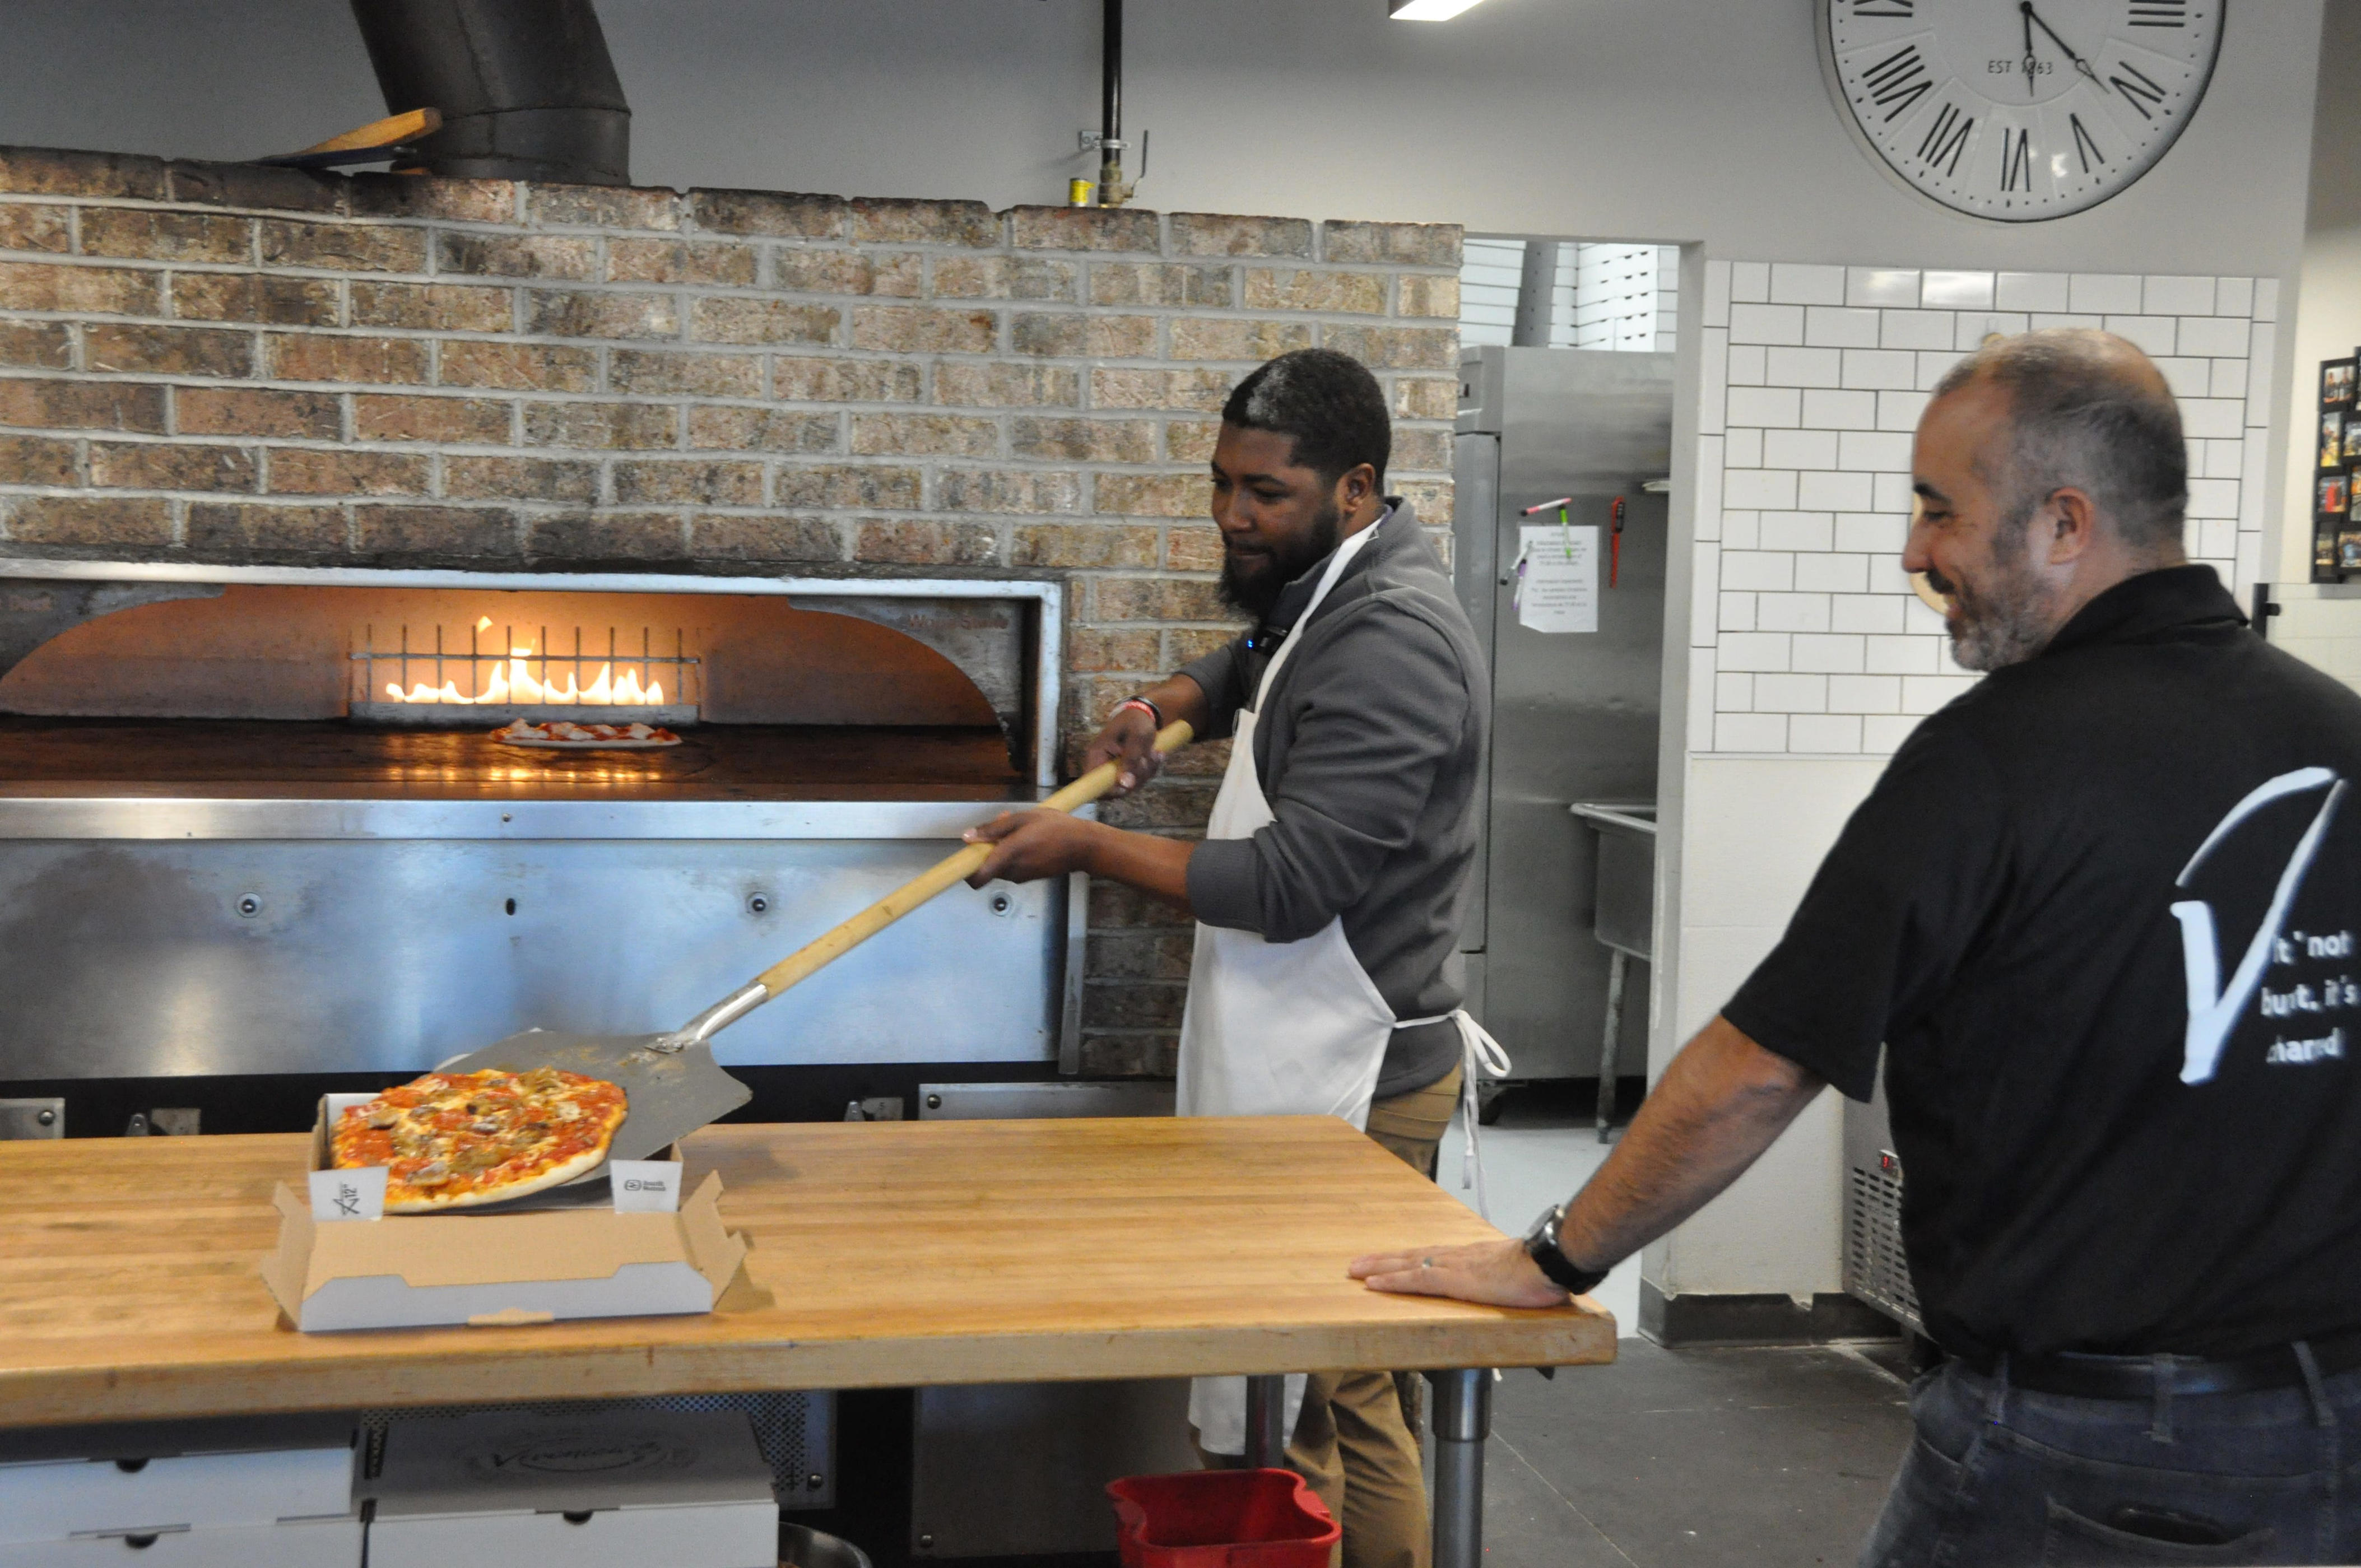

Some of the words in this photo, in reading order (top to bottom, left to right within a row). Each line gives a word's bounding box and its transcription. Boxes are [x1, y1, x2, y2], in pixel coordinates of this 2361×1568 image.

[1862, 45, 1932, 123] VIII
[1988, 60, 2012, 74] EST
[1917, 103, 1973, 177] VII
[2001, 128, 2031, 192] VI
[2070, 113, 2104, 174] V
